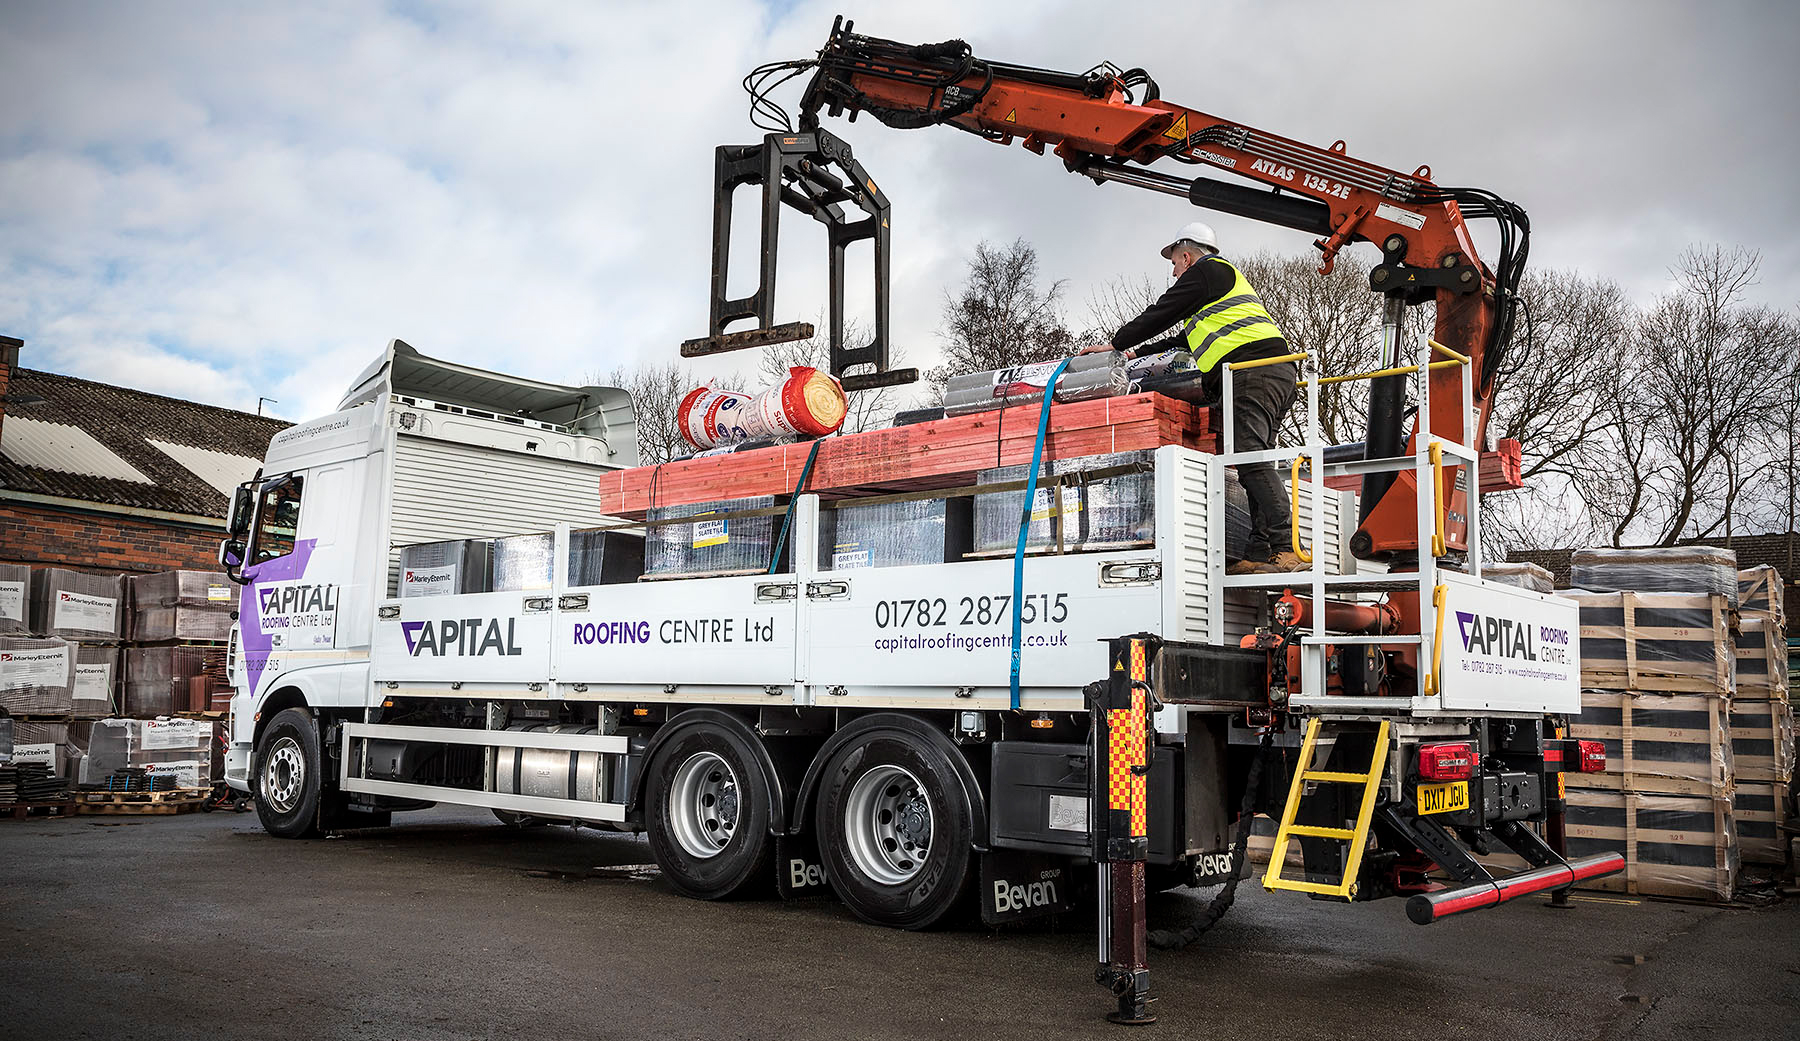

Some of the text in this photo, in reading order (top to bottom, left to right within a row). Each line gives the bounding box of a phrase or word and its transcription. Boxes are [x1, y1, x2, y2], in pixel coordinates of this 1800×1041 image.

[1250, 158, 1352, 200] ATLAS 135.2E
[773, 410, 796, 434] Super
[838, 552, 868, 563] GREY FLAT
[414, 573, 451, 584] MarleyEternit
[70, 596, 113, 608] MarleyEternit
[259, 584, 335, 615] CAPITAL
[875, 592, 1069, 629] 01782 287 515
[262, 613, 333, 629] ROOFING CENTRE Ltd
[573, 616, 775, 645] ROOFING CENTRE Ltd
[400, 617, 523, 657] CAPITAL
[874, 630, 1069, 652] capitalroofingcentr.co.uk
[1455, 610, 1537, 662] CAPITAL
[1540, 625, 1569, 645] ROOFING
[13, 652, 64, 662] MarleyEternit
[268, 659, 280, 671] 515
[1540, 645, 1565, 665] CENTRE
[155, 765, 194, 773] MarleyEternit
[1423, 784, 1465, 812] DX17 JGU
[1053, 803, 1088, 825] Beva
[790, 858, 828, 889] Bev
[1040, 868, 1061, 880] GROUP
[993, 879, 1058, 913] Bevan
